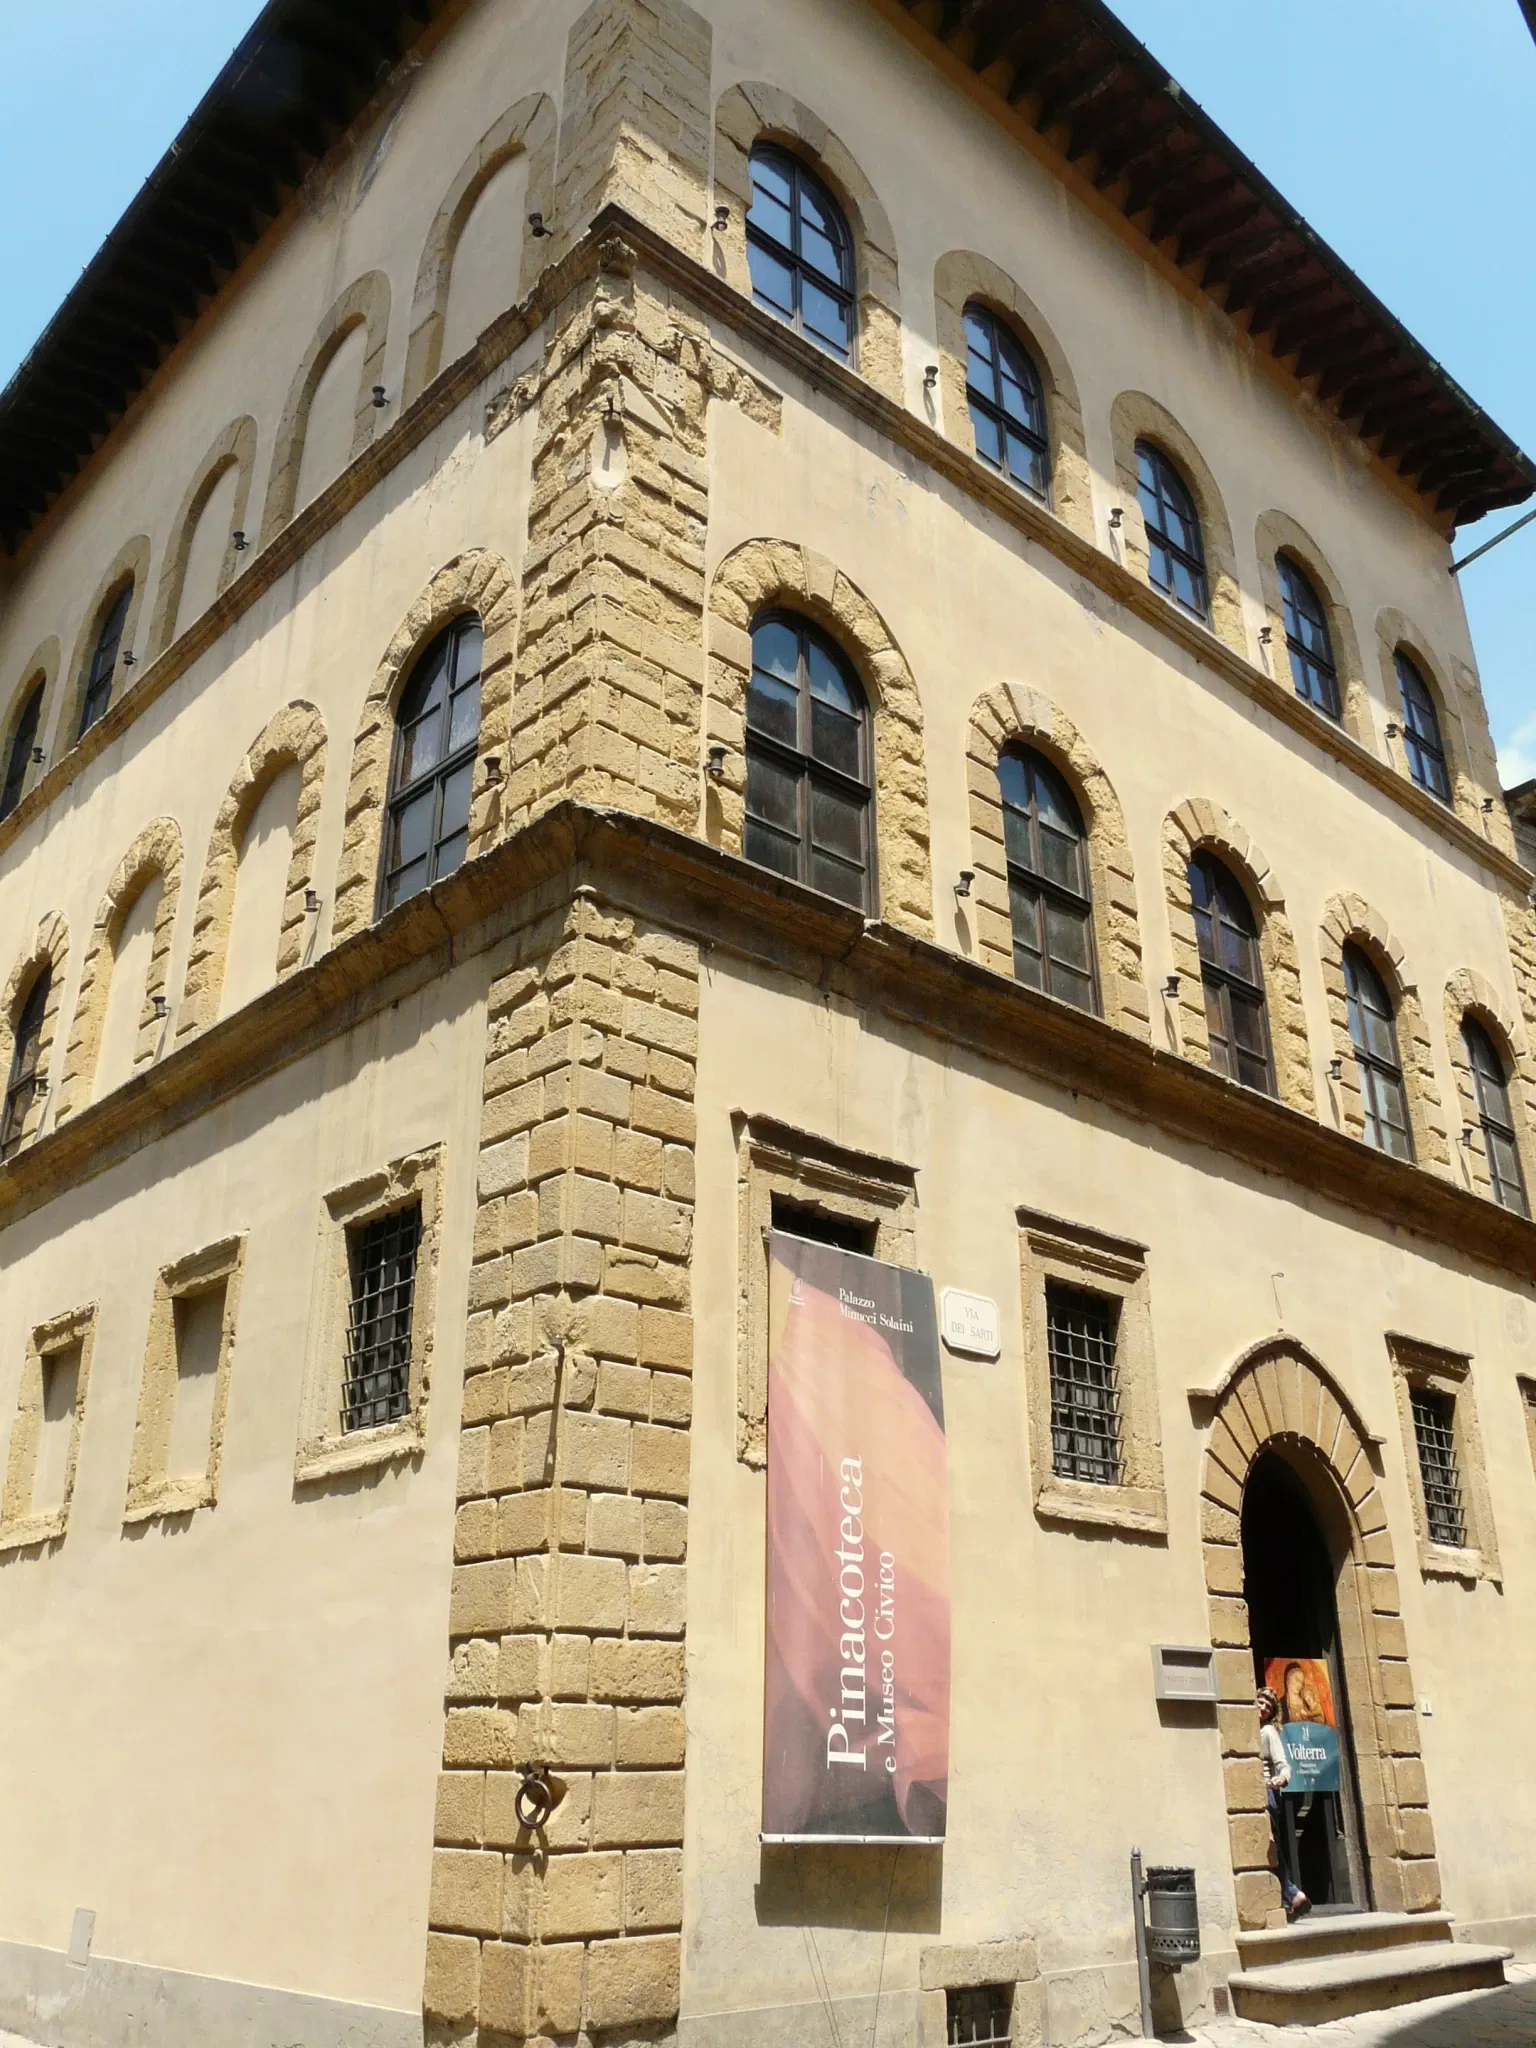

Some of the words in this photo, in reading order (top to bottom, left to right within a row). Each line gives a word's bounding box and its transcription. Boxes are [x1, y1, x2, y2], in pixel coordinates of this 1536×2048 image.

[839, 1287, 875, 1309] Palazzo
[839, 1303, 877, 1325] Minucci
[879, 1312, 914, 1333] Solaini
[964, 1307, 979, 1321] VIA
[951, 1321, 965, 1335] DEI
[970, 1326, 993, 1342] SARTI
[874, 1551, 896, 1640] Civico
[827, 1454, 867, 1772] Pinacoteca
[877, 1650, 896, 1746] Museo
[1287, 1743, 1327, 1760] Volterra
[884, 1756, 897, 1773] e
